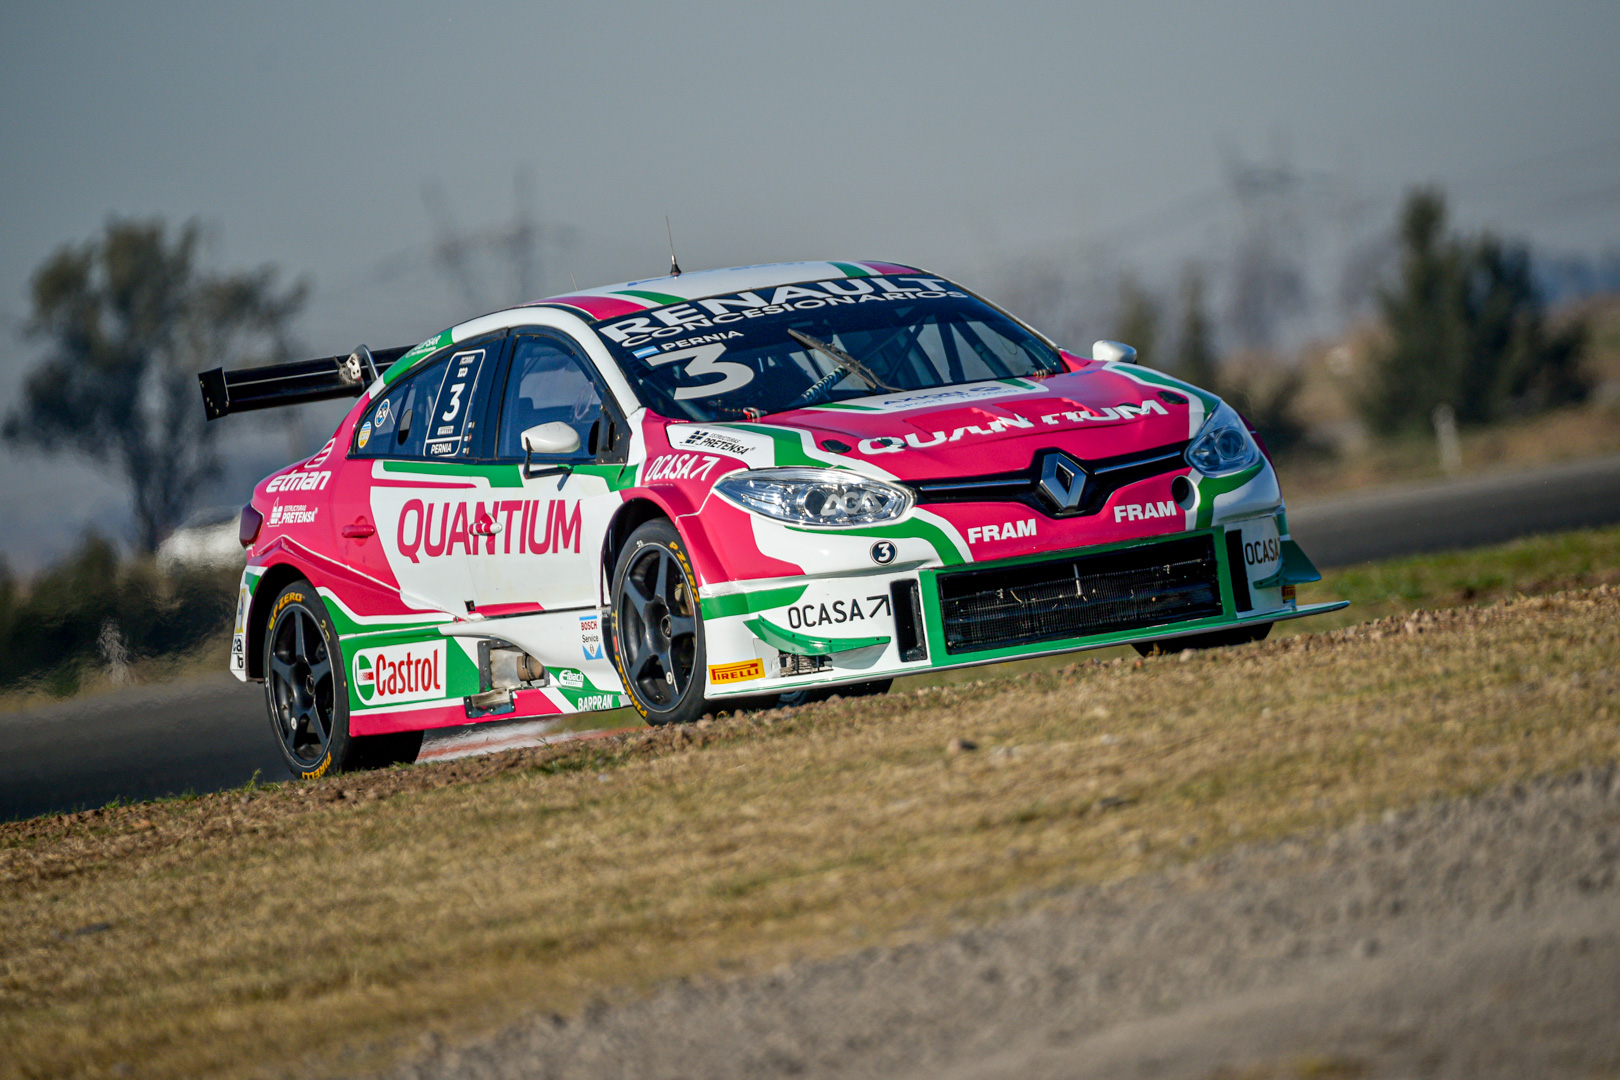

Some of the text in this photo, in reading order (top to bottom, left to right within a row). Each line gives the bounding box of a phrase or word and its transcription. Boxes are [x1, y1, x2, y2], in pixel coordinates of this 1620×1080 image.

[599, 277, 949, 343] RENAULT
[621, 290, 968, 348] CONCESIONARIOS
[661, 329, 744, 352] PERNIA
[645, 342, 755, 400] 3
[442, 383, 465, 421] 3
[857, 399, 1169, 455] QUANTIUM
[431, 443, 452, 455] PERNIA
[699, 437, 750, 455] PRETENSA
[644, 453, 699, 482] OCASA
[281, 511, 315, 524] PRETENSA
[1113, 500, 1177, 523] FRAM
[397, 498, 582, 564] QUANTIUM
[967, 518, 1037, 544] FRAM
[877, 542, 891, 562] 3
[669, 541, 700, 604] P ZERO
[278, 592, 303, 611] ZERO
[788, 598, 865, 629] OCASA
[580, 620, 598, 631] BOSCH
[581, 634, 599, 643] Service
[375, 648, 441, 697] Castrol
[559, 669, 584, 683] Eibach
[711, 663, 759, 681] PIRELLI
[577, 694, 613, 712] BARPRAN
